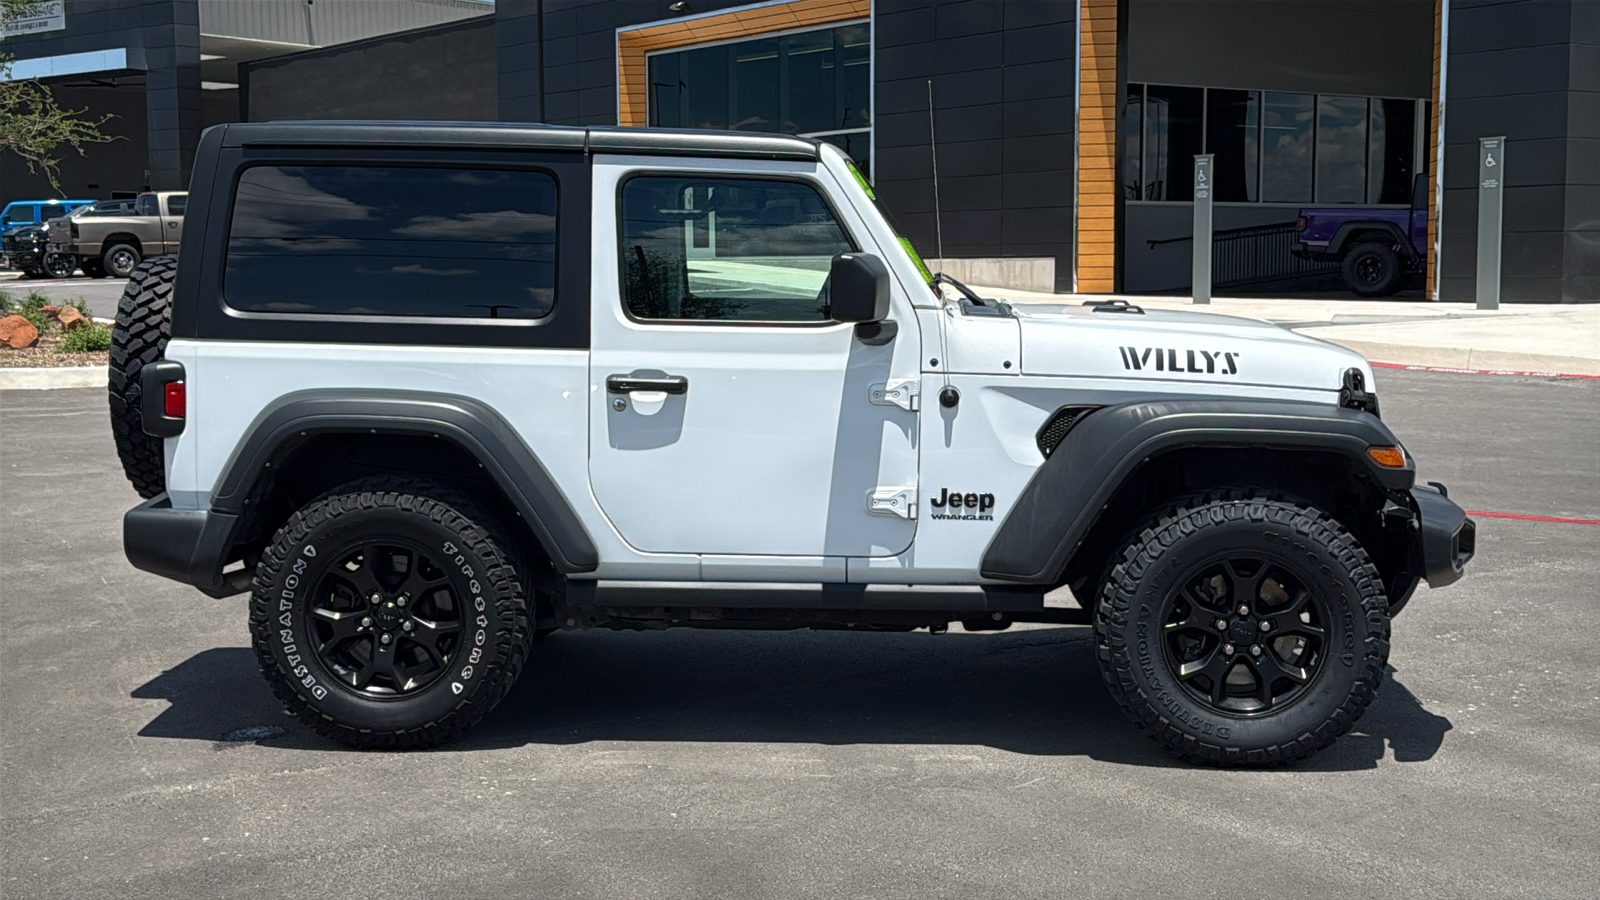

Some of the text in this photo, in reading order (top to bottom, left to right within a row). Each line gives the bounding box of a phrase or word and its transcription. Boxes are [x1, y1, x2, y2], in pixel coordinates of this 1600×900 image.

[1119, 346, 1239, 375] WILLYS
[931, 486, 995, 512] Jeep
[280, 558, 327, 700] DESTINATION
[443, 543, 488, 678] Firestone
[1137, 621, 1231, 739] DESTINATION
